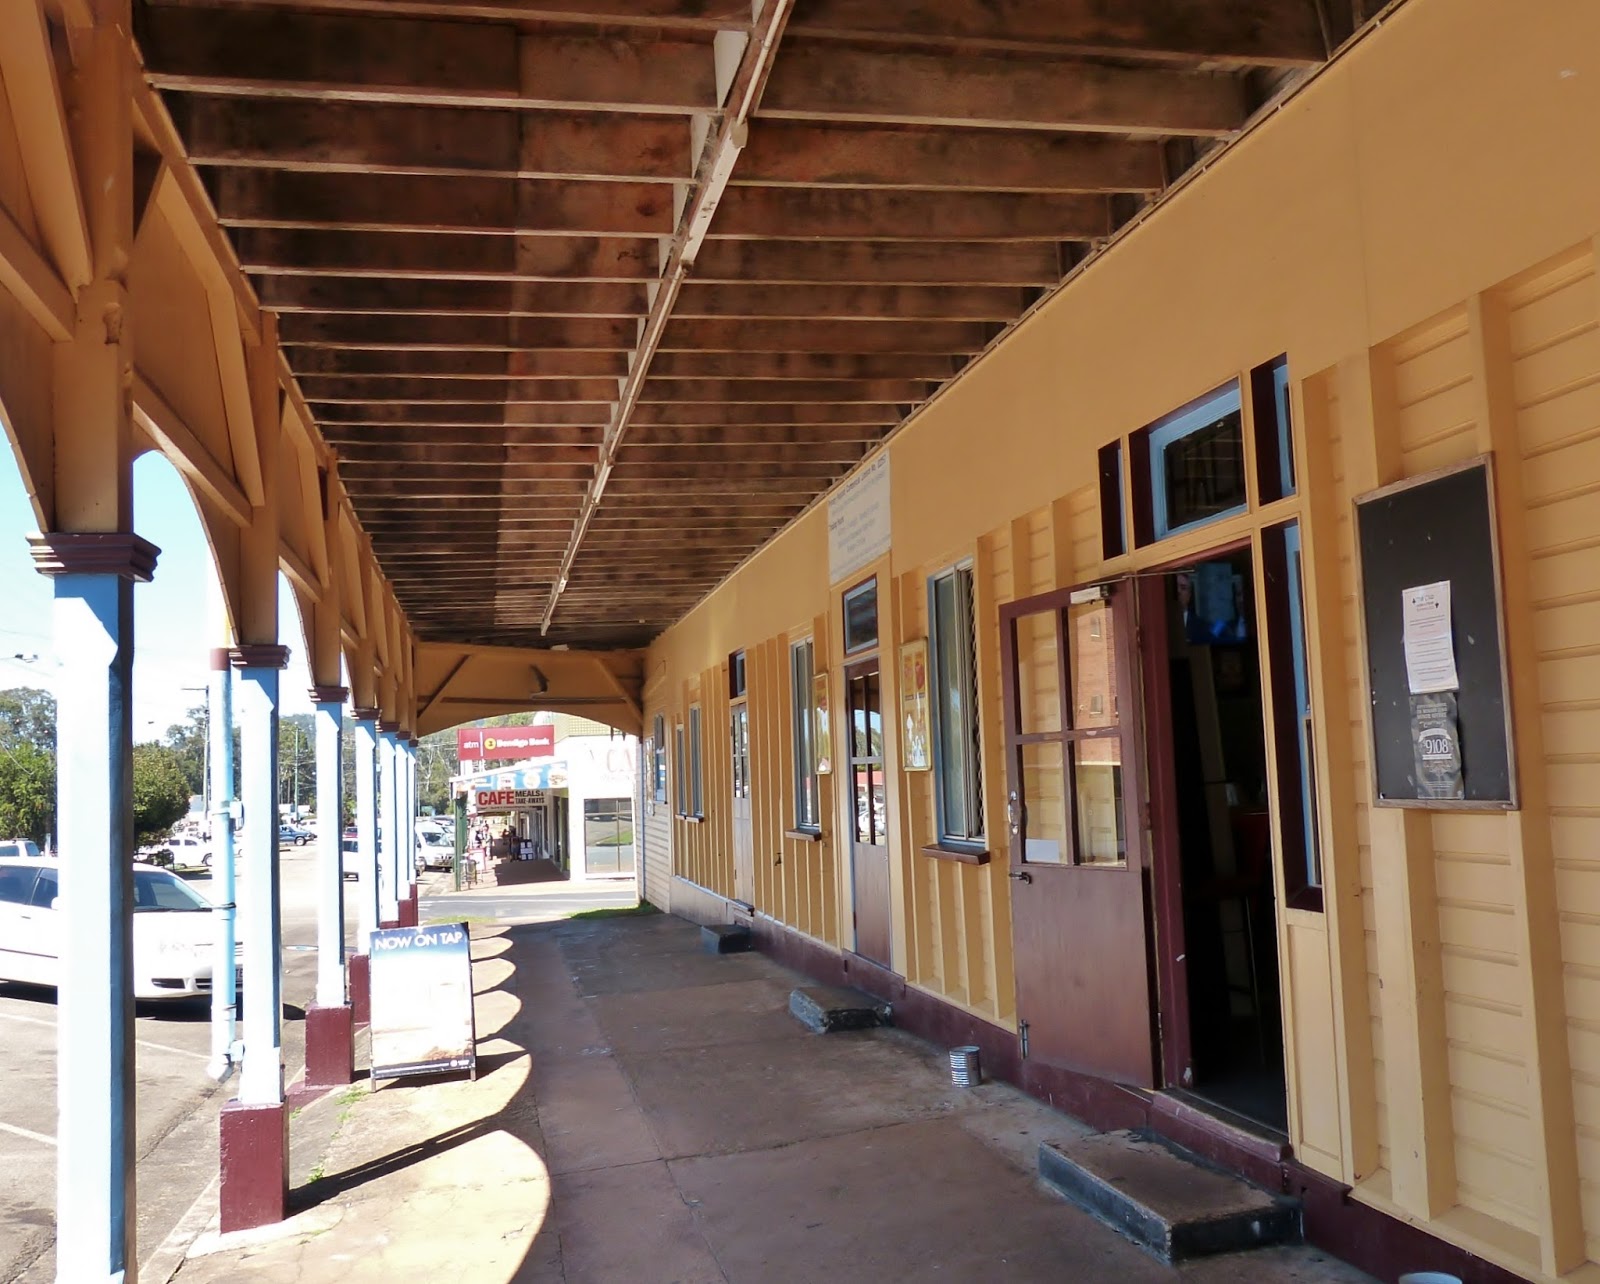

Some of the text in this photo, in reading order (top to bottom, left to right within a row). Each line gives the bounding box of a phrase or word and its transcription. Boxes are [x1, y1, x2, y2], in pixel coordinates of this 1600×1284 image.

[463, 741, 479, 749] atm
[1425, 738, 1449, 754] 9108
[478, 790, 515, 806] CAFE
[515, 790, 540, 798] MEALS
[375, 931, 463, 950] NOW ON TAP
